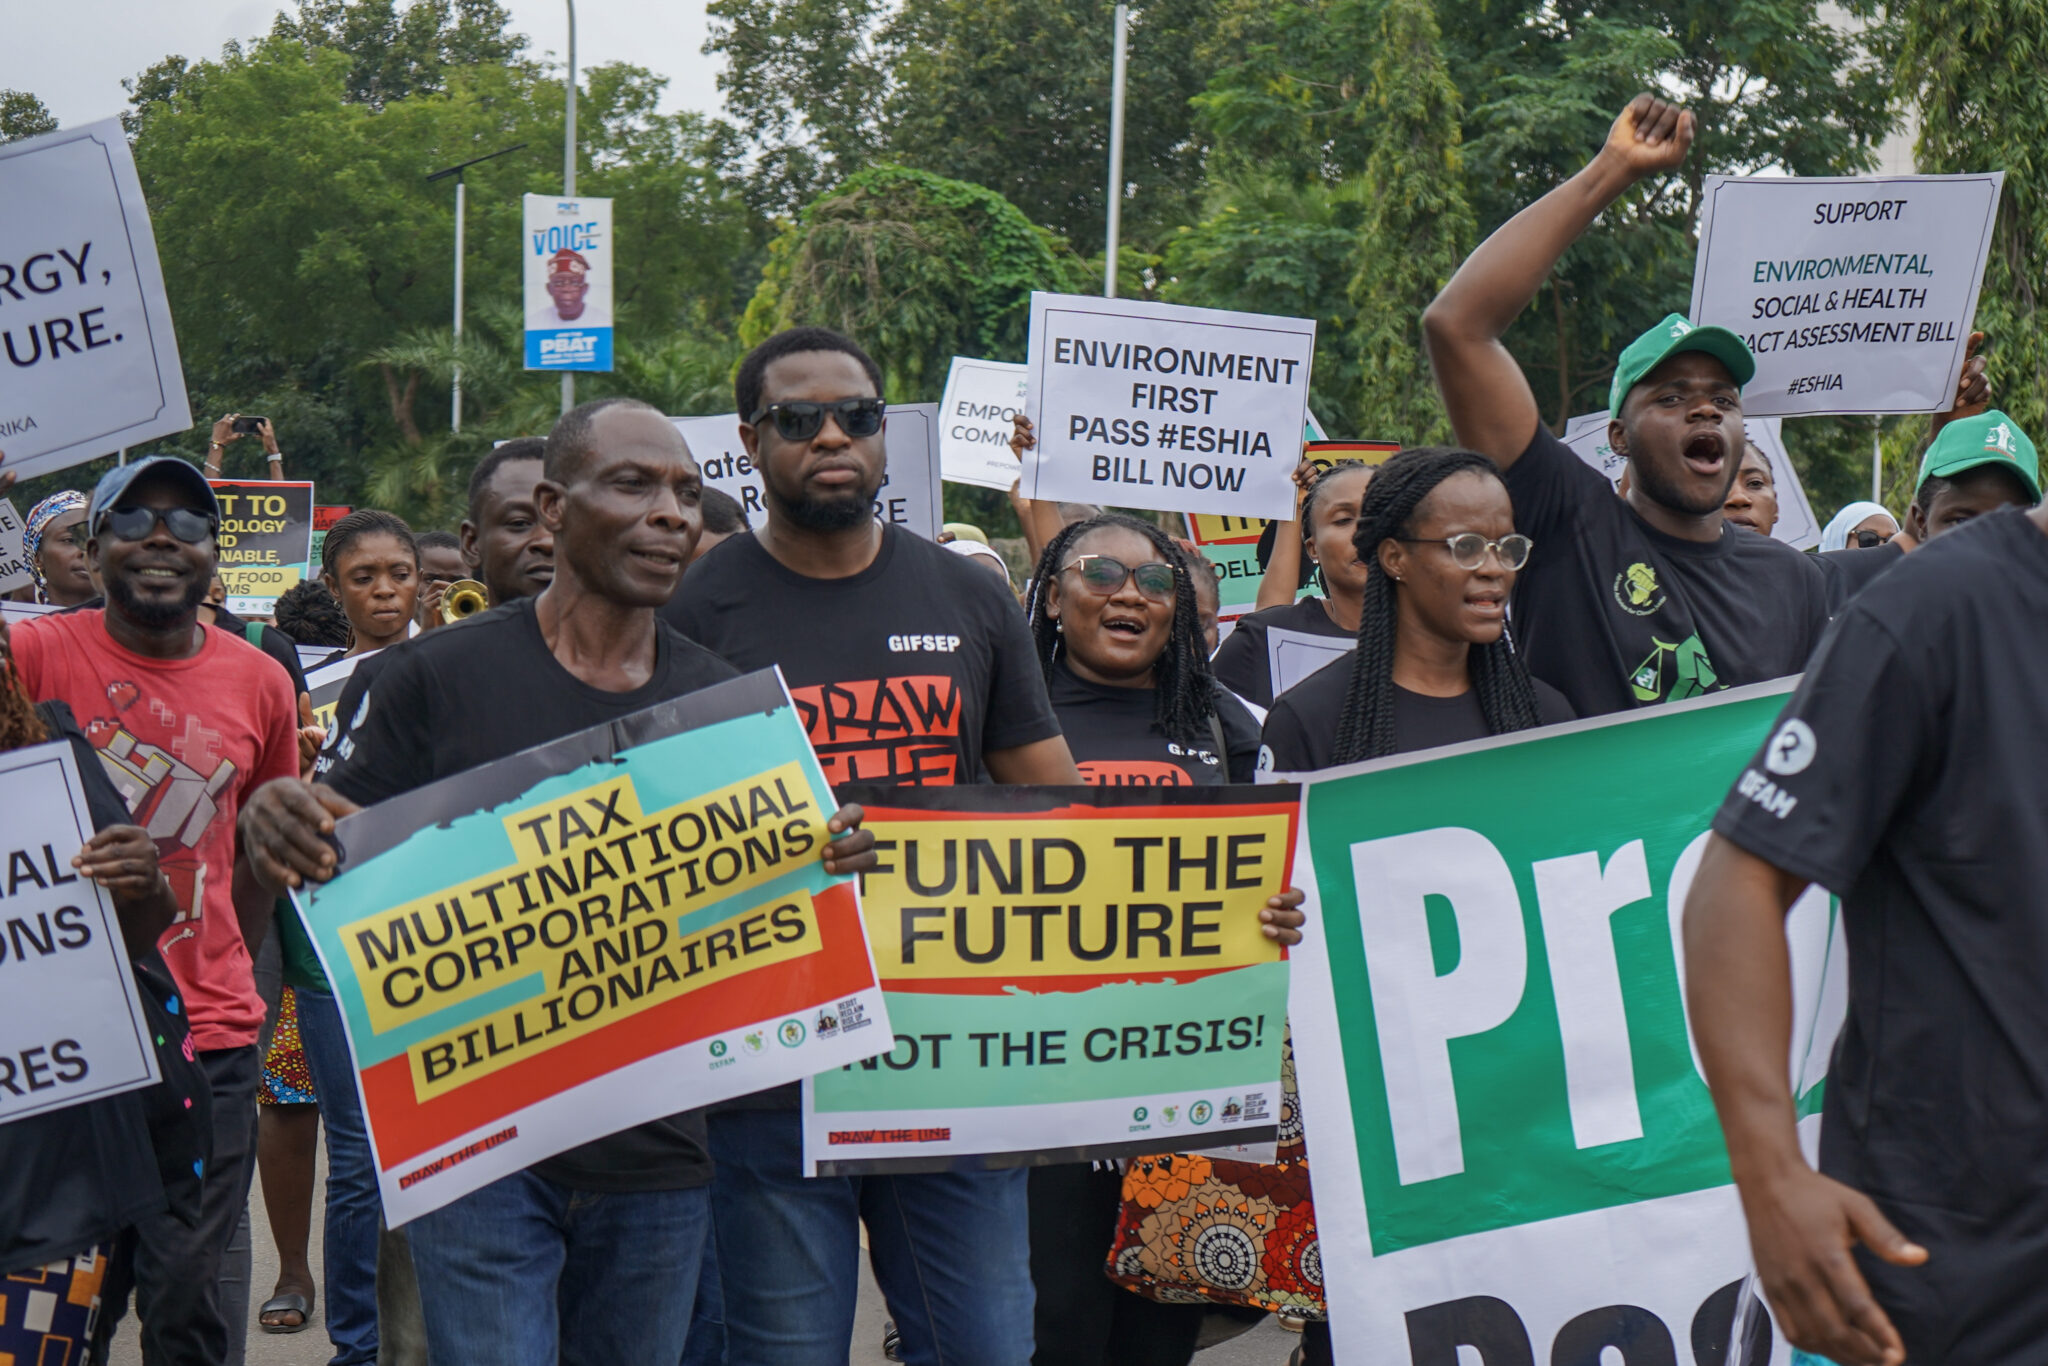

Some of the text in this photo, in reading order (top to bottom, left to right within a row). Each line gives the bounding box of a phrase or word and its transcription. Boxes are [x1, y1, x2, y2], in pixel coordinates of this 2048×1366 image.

[1813, 200, 1907, 224] SUPPORT
[533, 222, 598, 256] VOICE
[1753, 254, 1934, 283] ENVIRONMENTAL,
[1752, 288, 1927, 319] SOCIAL & HEALTH
[539, 336, 598, 354] PBAT
[1784, 322, 1915, 350] ASSESSMENT
[1916, 321, 1955, 342] BILL
[1054, 337, 1299, 384] ENVIRONMENT
[1131, 382, 1218, 414] FIRST
[1787, 374, 1843, 395] #ESHIA
[956, 401, 1023, 423] EMPO
[1069, 415, 1272, 458] PASS #ESHIA
[693, 452, 752, 480] ate
[1092, 454, 1246, 492] BILL NOW
[246, 495, 287, 516] TO
[237, 572, 283, 583] FOOD
[888, 635, 960, 652] GIFSEP
[518, 788, 632, 857] TAX
[0, 843, 78, 898] AL
[355, 777, 809, 970] MULTINATIONAL
[859, 833, 1266, 897] FUND THE
[382, 818, 814, 1010] CORPORATIONS
[901, 900, 1223, 964] FUTURE
[557, 919, 668, 990] AND
[421, 903, 806, 1084] BILLIONAIRES
[969, 1029, 1067, 1068] THE
[1083, 1014, 1266, 1063] CRISIS!
[880, 1129, 914, 1143] THE
[399, 1157, 445, 1190] DRAW
[449, 1143, 482, 1166] THE
